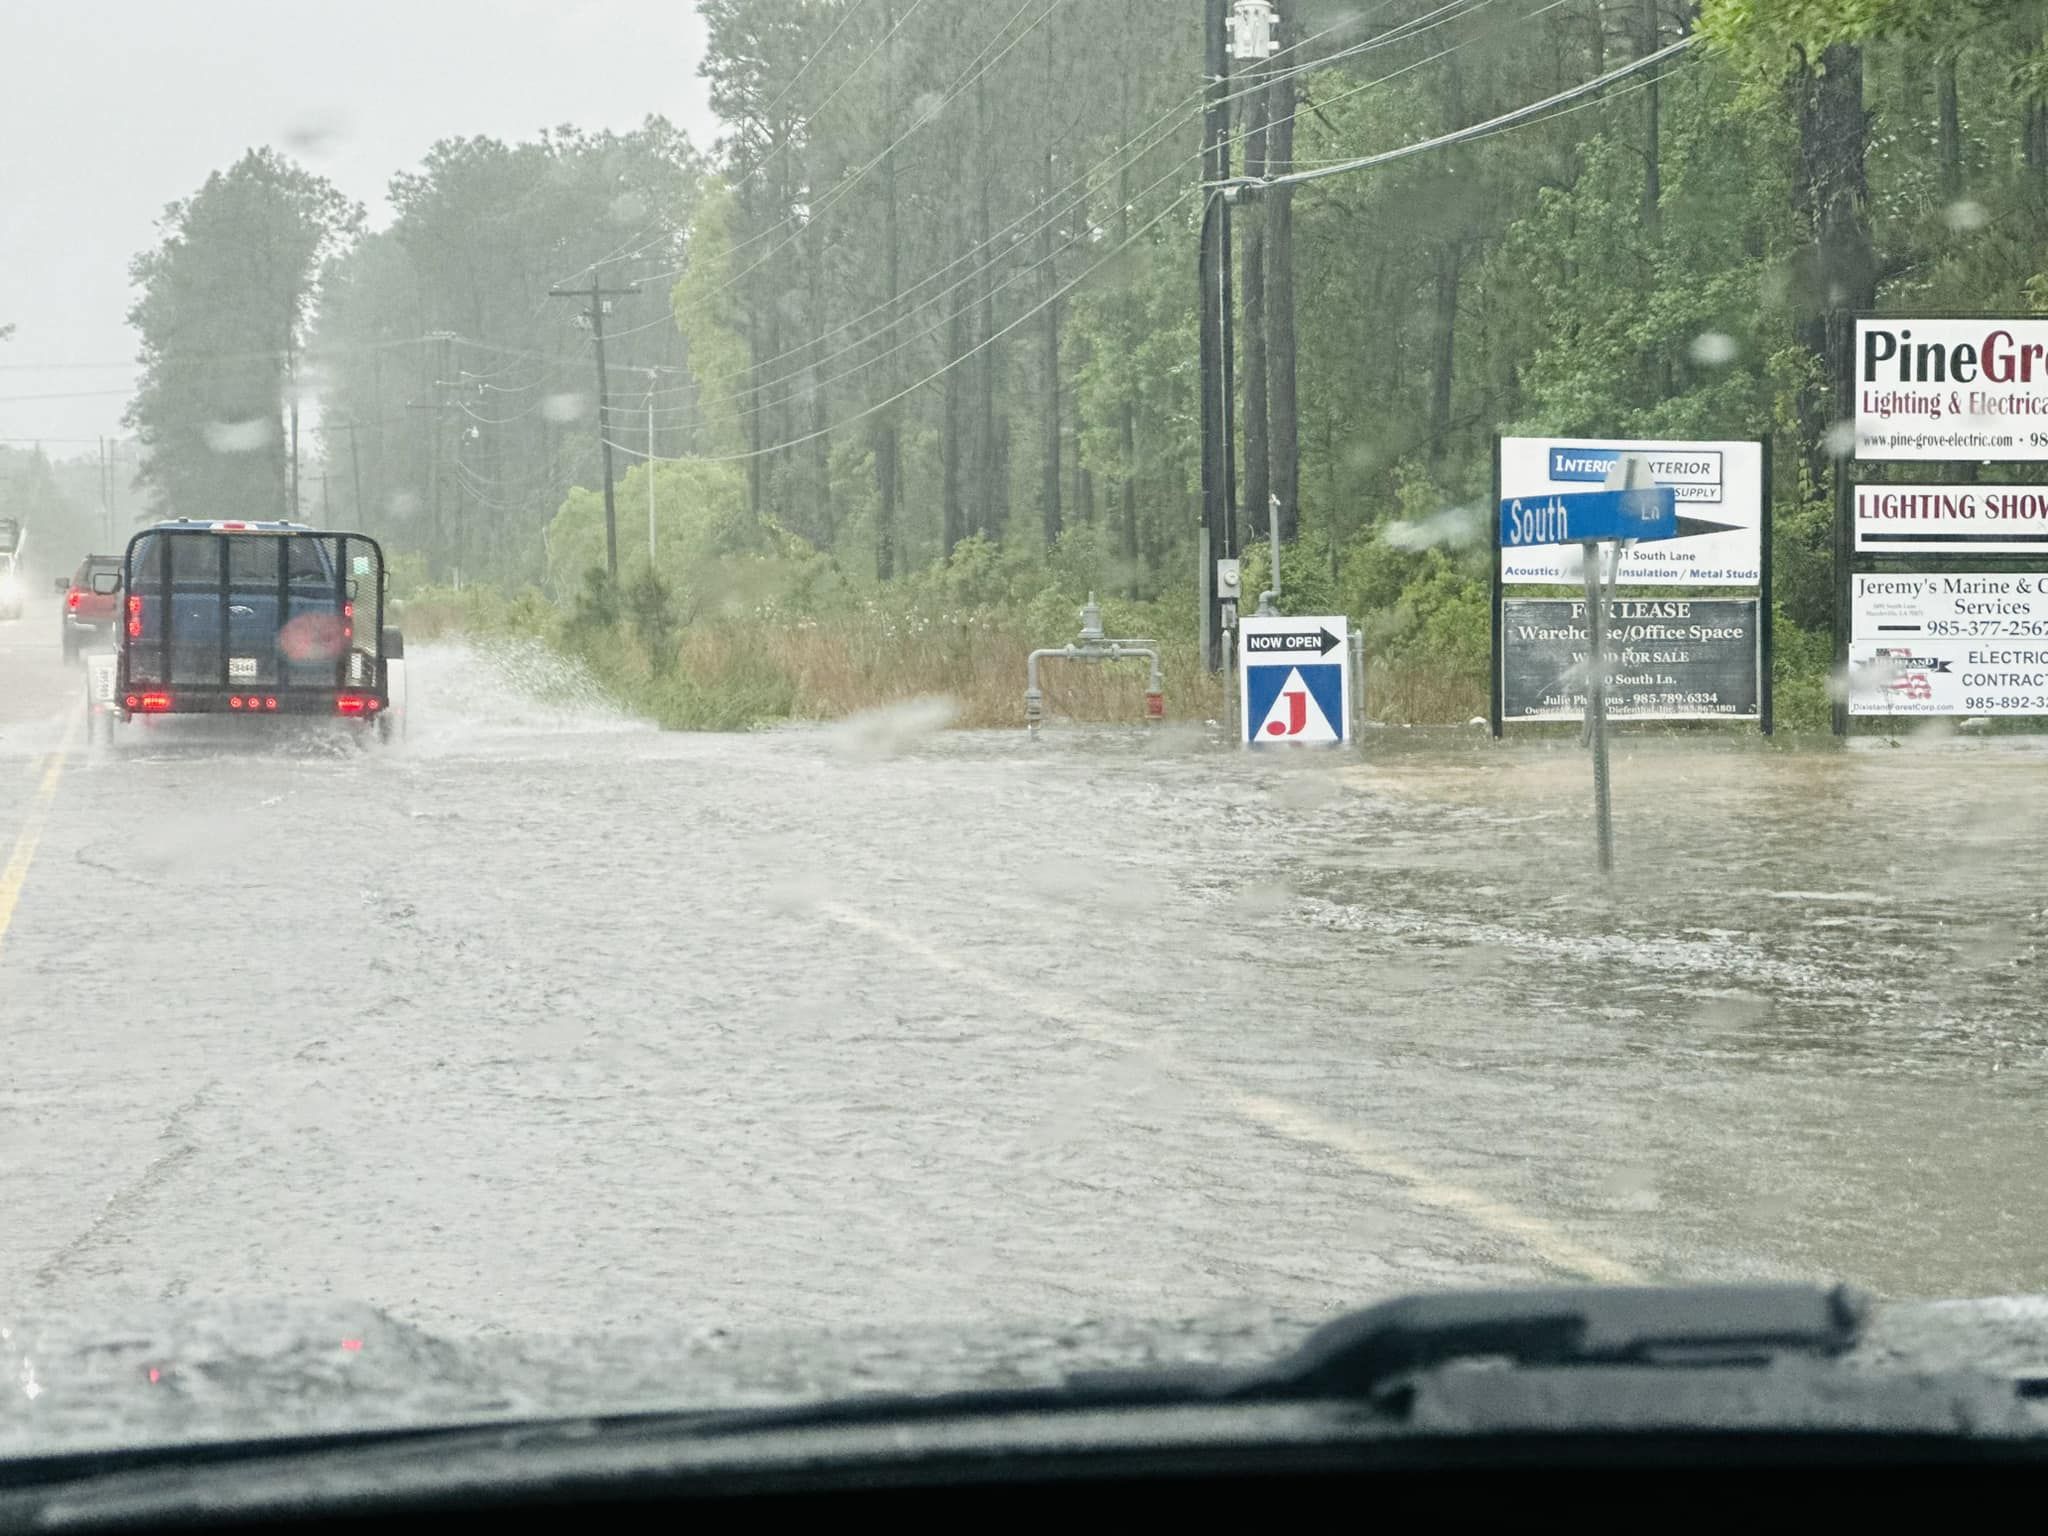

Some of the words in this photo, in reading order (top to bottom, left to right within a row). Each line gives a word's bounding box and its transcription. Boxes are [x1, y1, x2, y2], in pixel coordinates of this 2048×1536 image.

[1864, 329, 2048, 383] PineGr
[1863, 390, 1942, 419] Lighting
[1948, 391, 1961, 414] &
[1863, 432, 2013, 449] www.pine-grove-electric.com
[1555, 453, 1616, 473] INTERIO
[1648, 461, 1710, 474] XTERIOR
[1675, 487, 1717, 498] SUPPLY
[1858, 493, 1976, 519] LIGHTING
[1510, 496, 1568, 544] South
[1641, 503, 1660, 521] Ln
[1633, 551, 1666, 561] South
[1670, 551, 1696, 561] Lane
[1505, 565, 1560, 577] Acoustics
[1689, 568, 1724, 579] Metal
[1727, 568, 1759, 579] Studs
[1858, 577, 1937, 599] Jeremy's
[1943, 578, 2010, 594] Marine
[2016, 577, 2032, 594] &
[1571, 603, 1617, 619] FR
[1620, 603, 1691, 619] LEASE
[1954, 598, 2030, 615] Services
[1519, 625, 1686, 643] Warehose/Office
[1688, 626, 1744, 643] Space
[1250, 637, 1282, 649] NOW
[1286, 636, 1322, 648] OPEN
[1622, 652, 1651, 663] FOR
[1653, 652, 1689, 663] SALE
[1968, 651, 2048, 664] ELECTRIC
[1615, 673, 1653, 685] South
[1656, 674, 1677, 685] Ln.
[1543, 695, 1571, 706] Julie
[1633, 693, 1719, 704] 985.789.6334
[1965, 696, 2048, 710] 985-892-3
